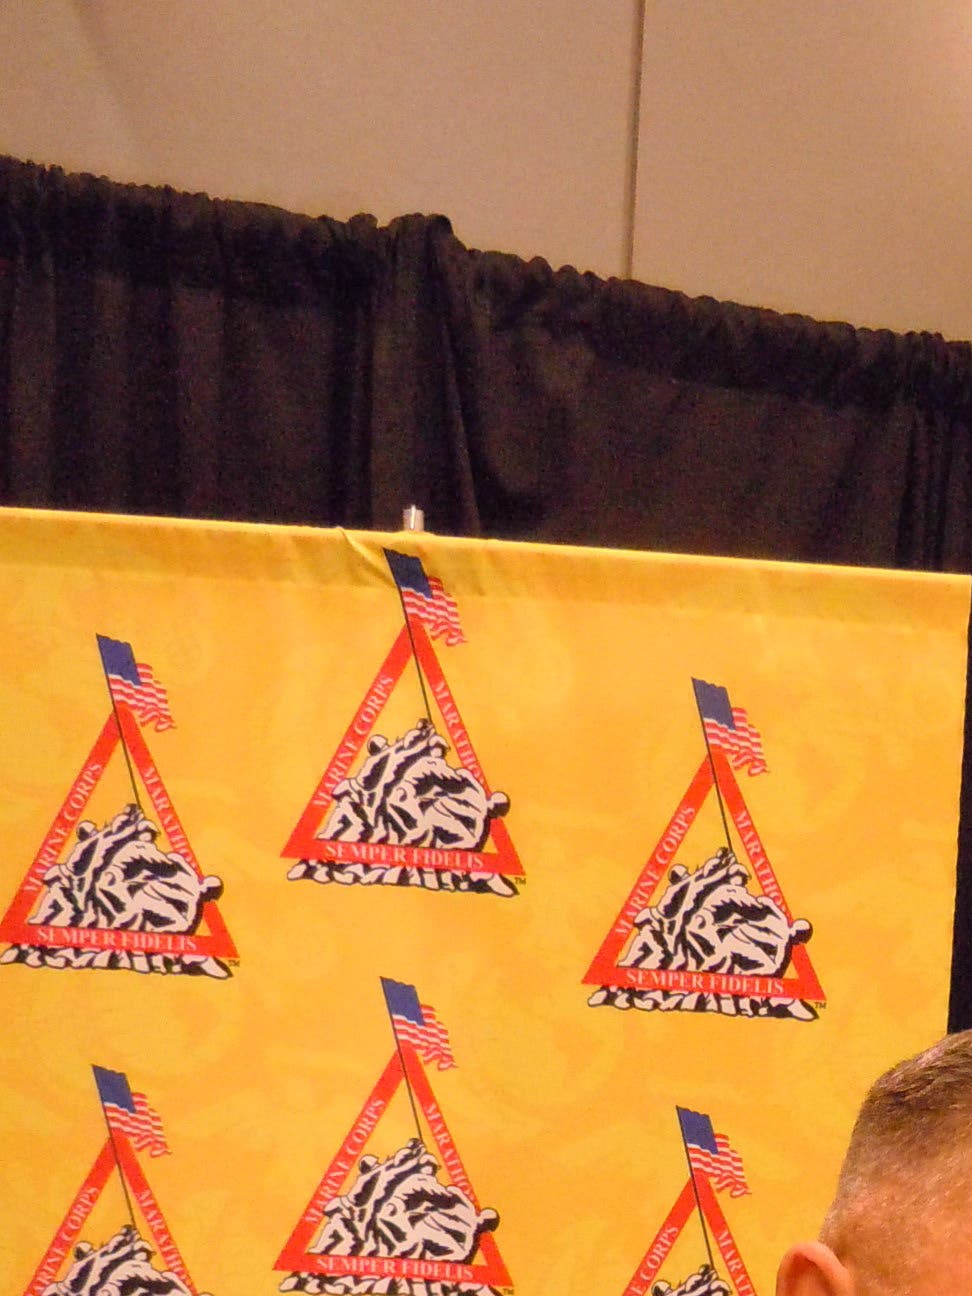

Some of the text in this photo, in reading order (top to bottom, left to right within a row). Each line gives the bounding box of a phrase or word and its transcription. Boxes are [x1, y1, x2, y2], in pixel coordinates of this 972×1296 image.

[313, 675, 393, 808] MARINE CORPS
[325, 843, 484, 868] SEMPER FIDELIS
[615, 806, 695, 936] MARINE CORPS
[735, 810, 787, 913] MARATHO
[626, 968, 784, 994] SEMPER FIDELIS
[640, 1225, 679, 1282] CORPS
